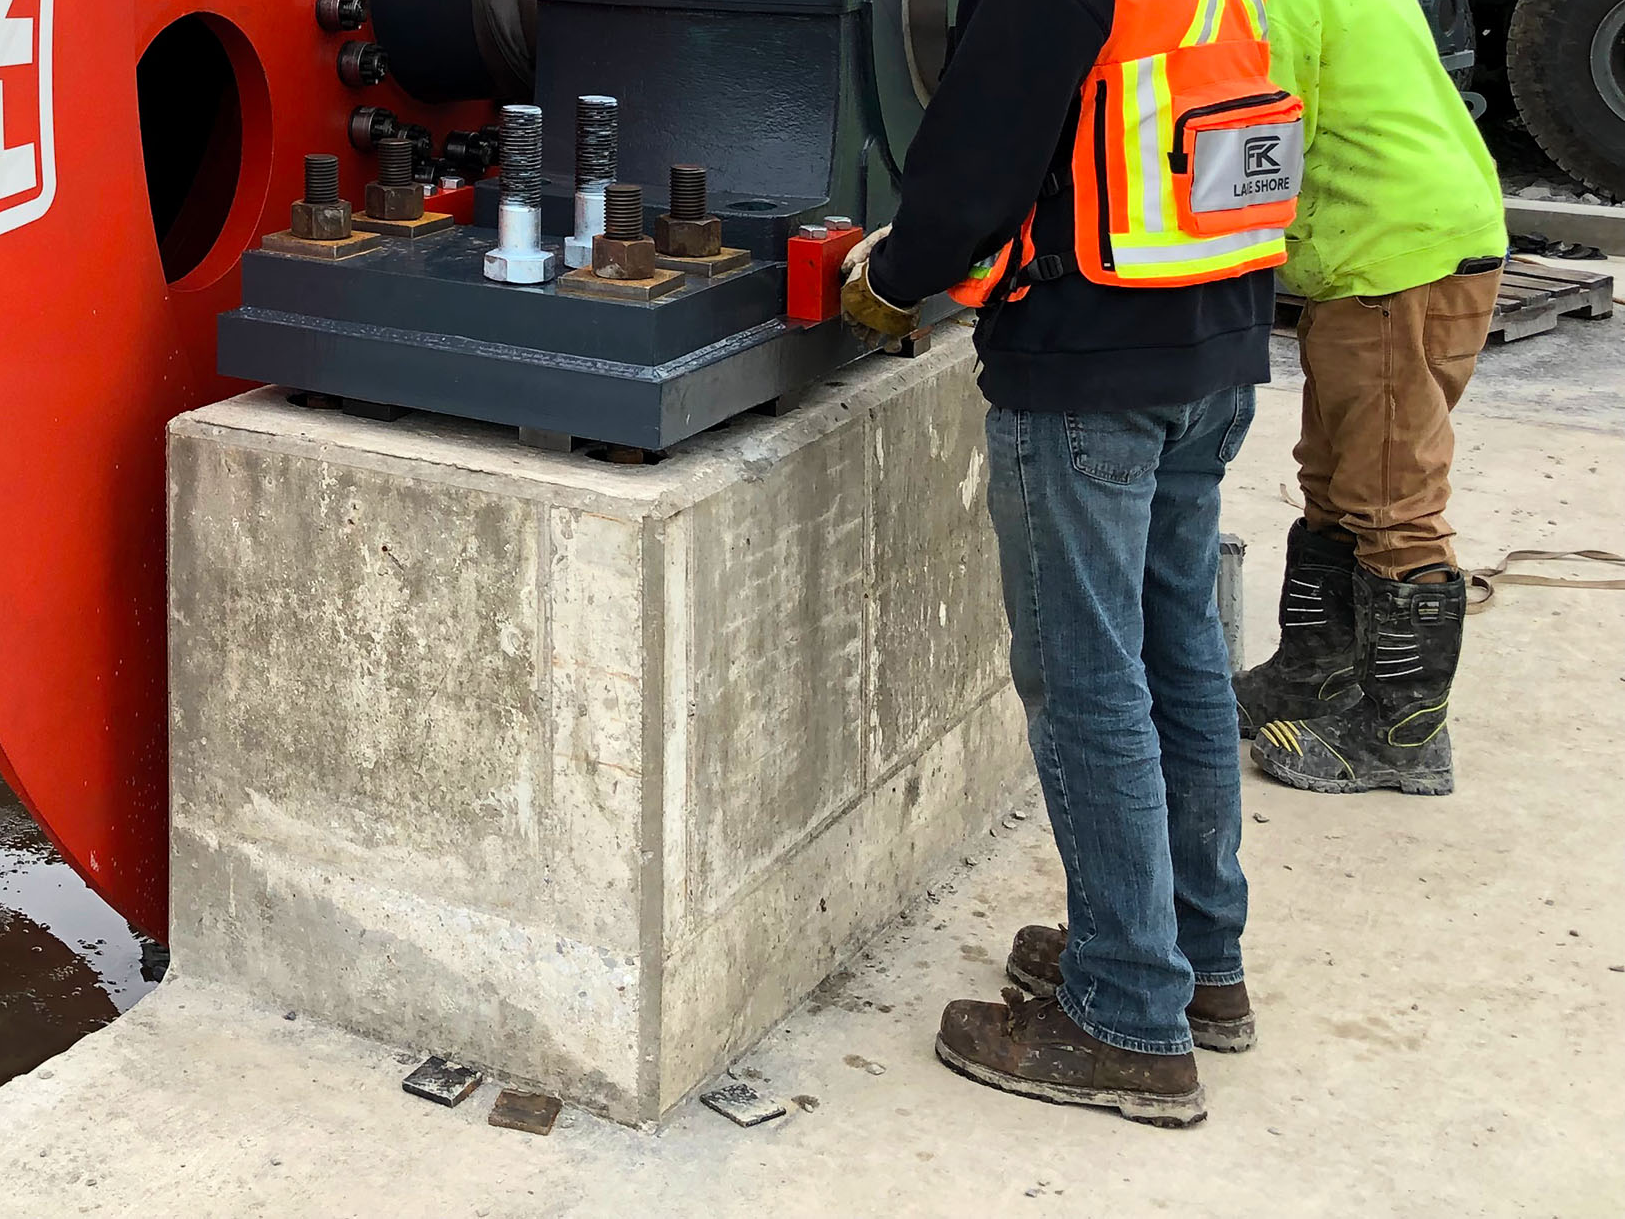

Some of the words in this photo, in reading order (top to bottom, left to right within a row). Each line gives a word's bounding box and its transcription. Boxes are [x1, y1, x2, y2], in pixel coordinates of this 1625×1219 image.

[1244, 139, 1281, 174] FK
[1233, 182, 1253, 198] LAE
[1254, 177, 1290, 193] SHORE
